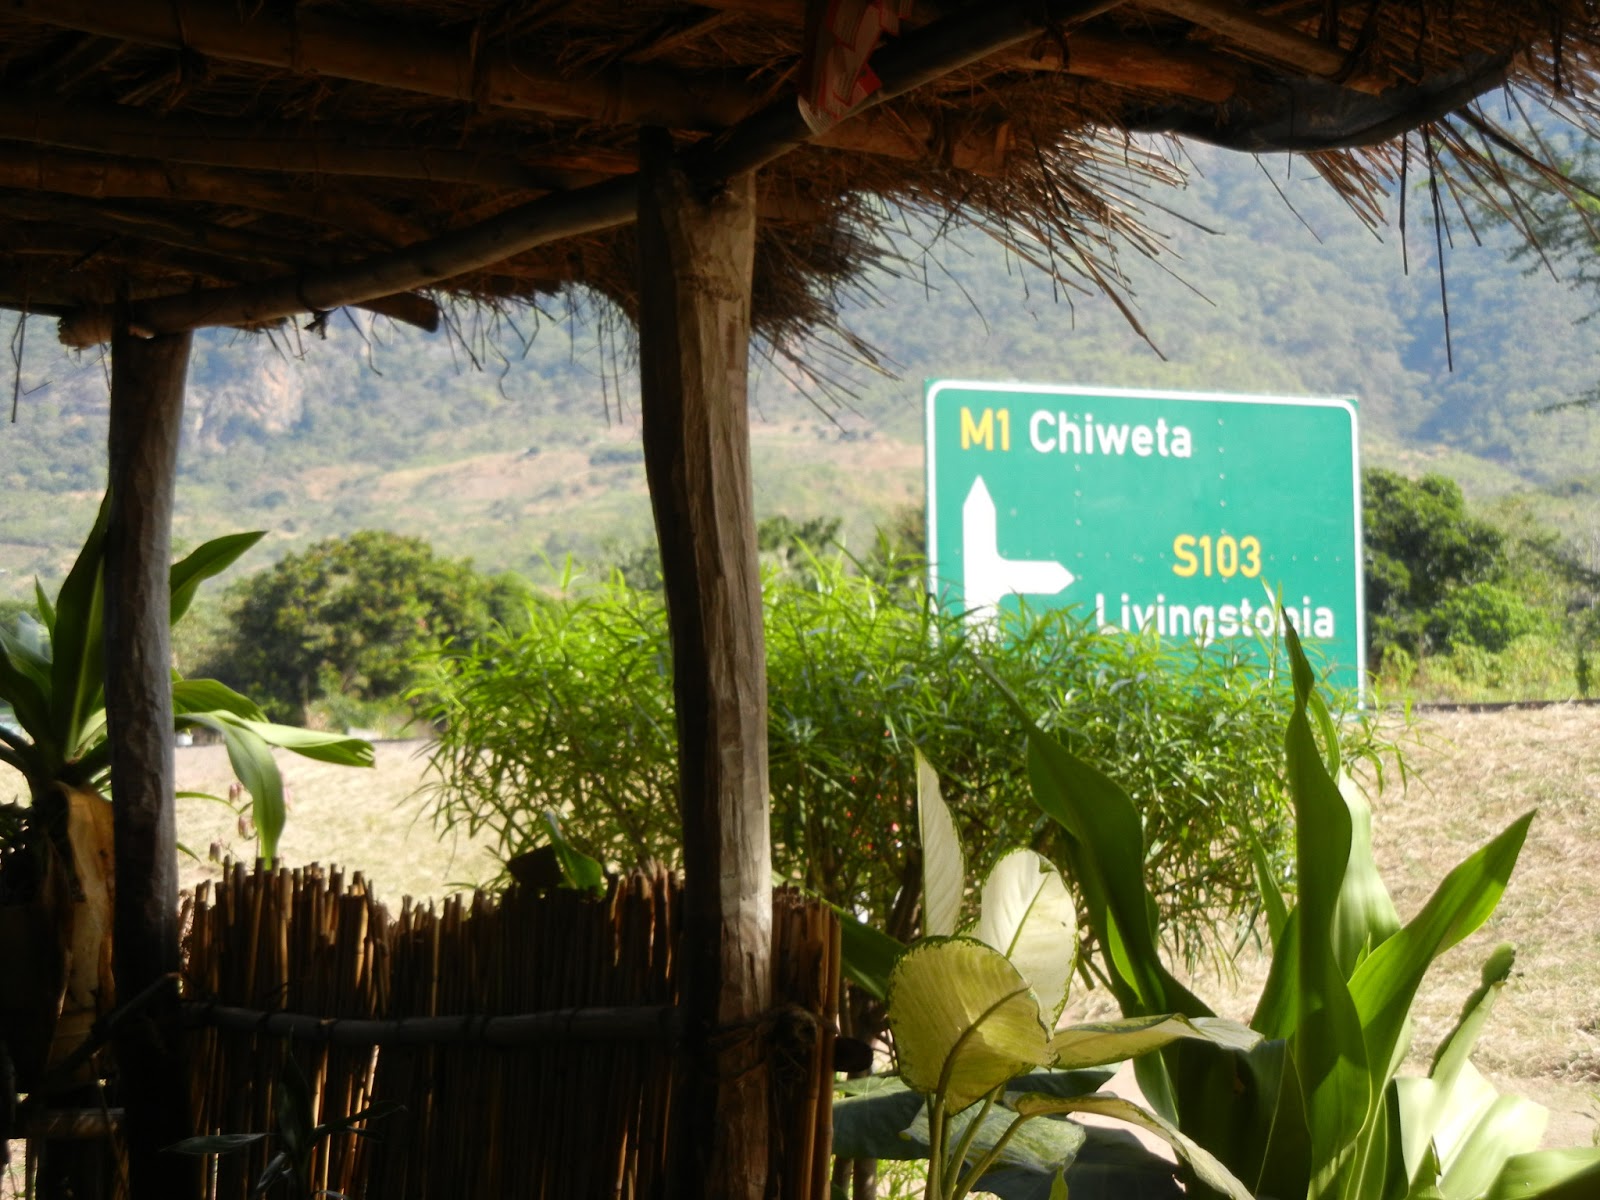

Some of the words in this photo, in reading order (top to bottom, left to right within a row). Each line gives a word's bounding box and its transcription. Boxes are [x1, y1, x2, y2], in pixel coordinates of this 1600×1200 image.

[960, 406, 1011, 451] M1
[1029, 409, 1193, 458] Chiweta
[1172, 534, 1262, 579] S103
